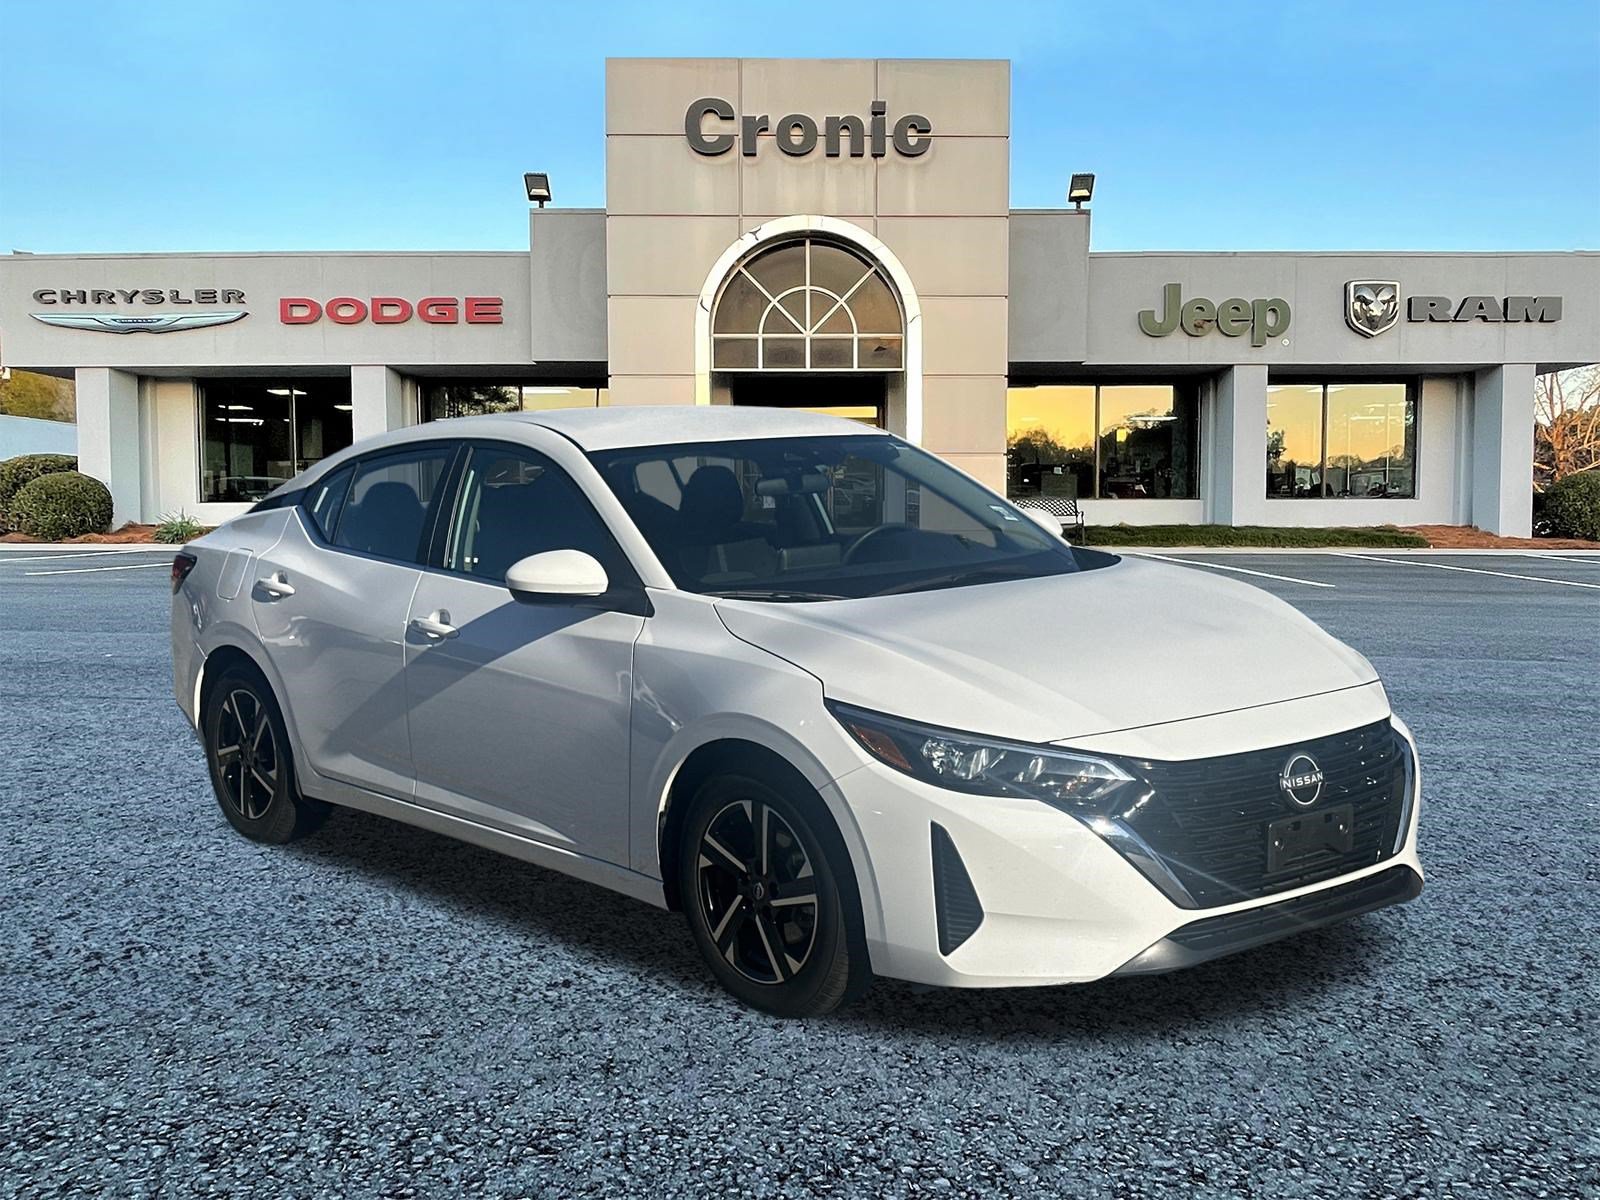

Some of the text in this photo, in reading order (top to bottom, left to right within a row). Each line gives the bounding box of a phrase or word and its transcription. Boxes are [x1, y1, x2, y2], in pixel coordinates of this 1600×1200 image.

[685, 98, 931, 158] Cronic
[32, 288, 247, 305] CHRYSLER
[1408, 296, 1563, 323] RAM
[280, 297, 504, 325] DODGE
[1138, 283, 1291, 347] Jeep
[1282, 771, 1323, 789] NISSAN
